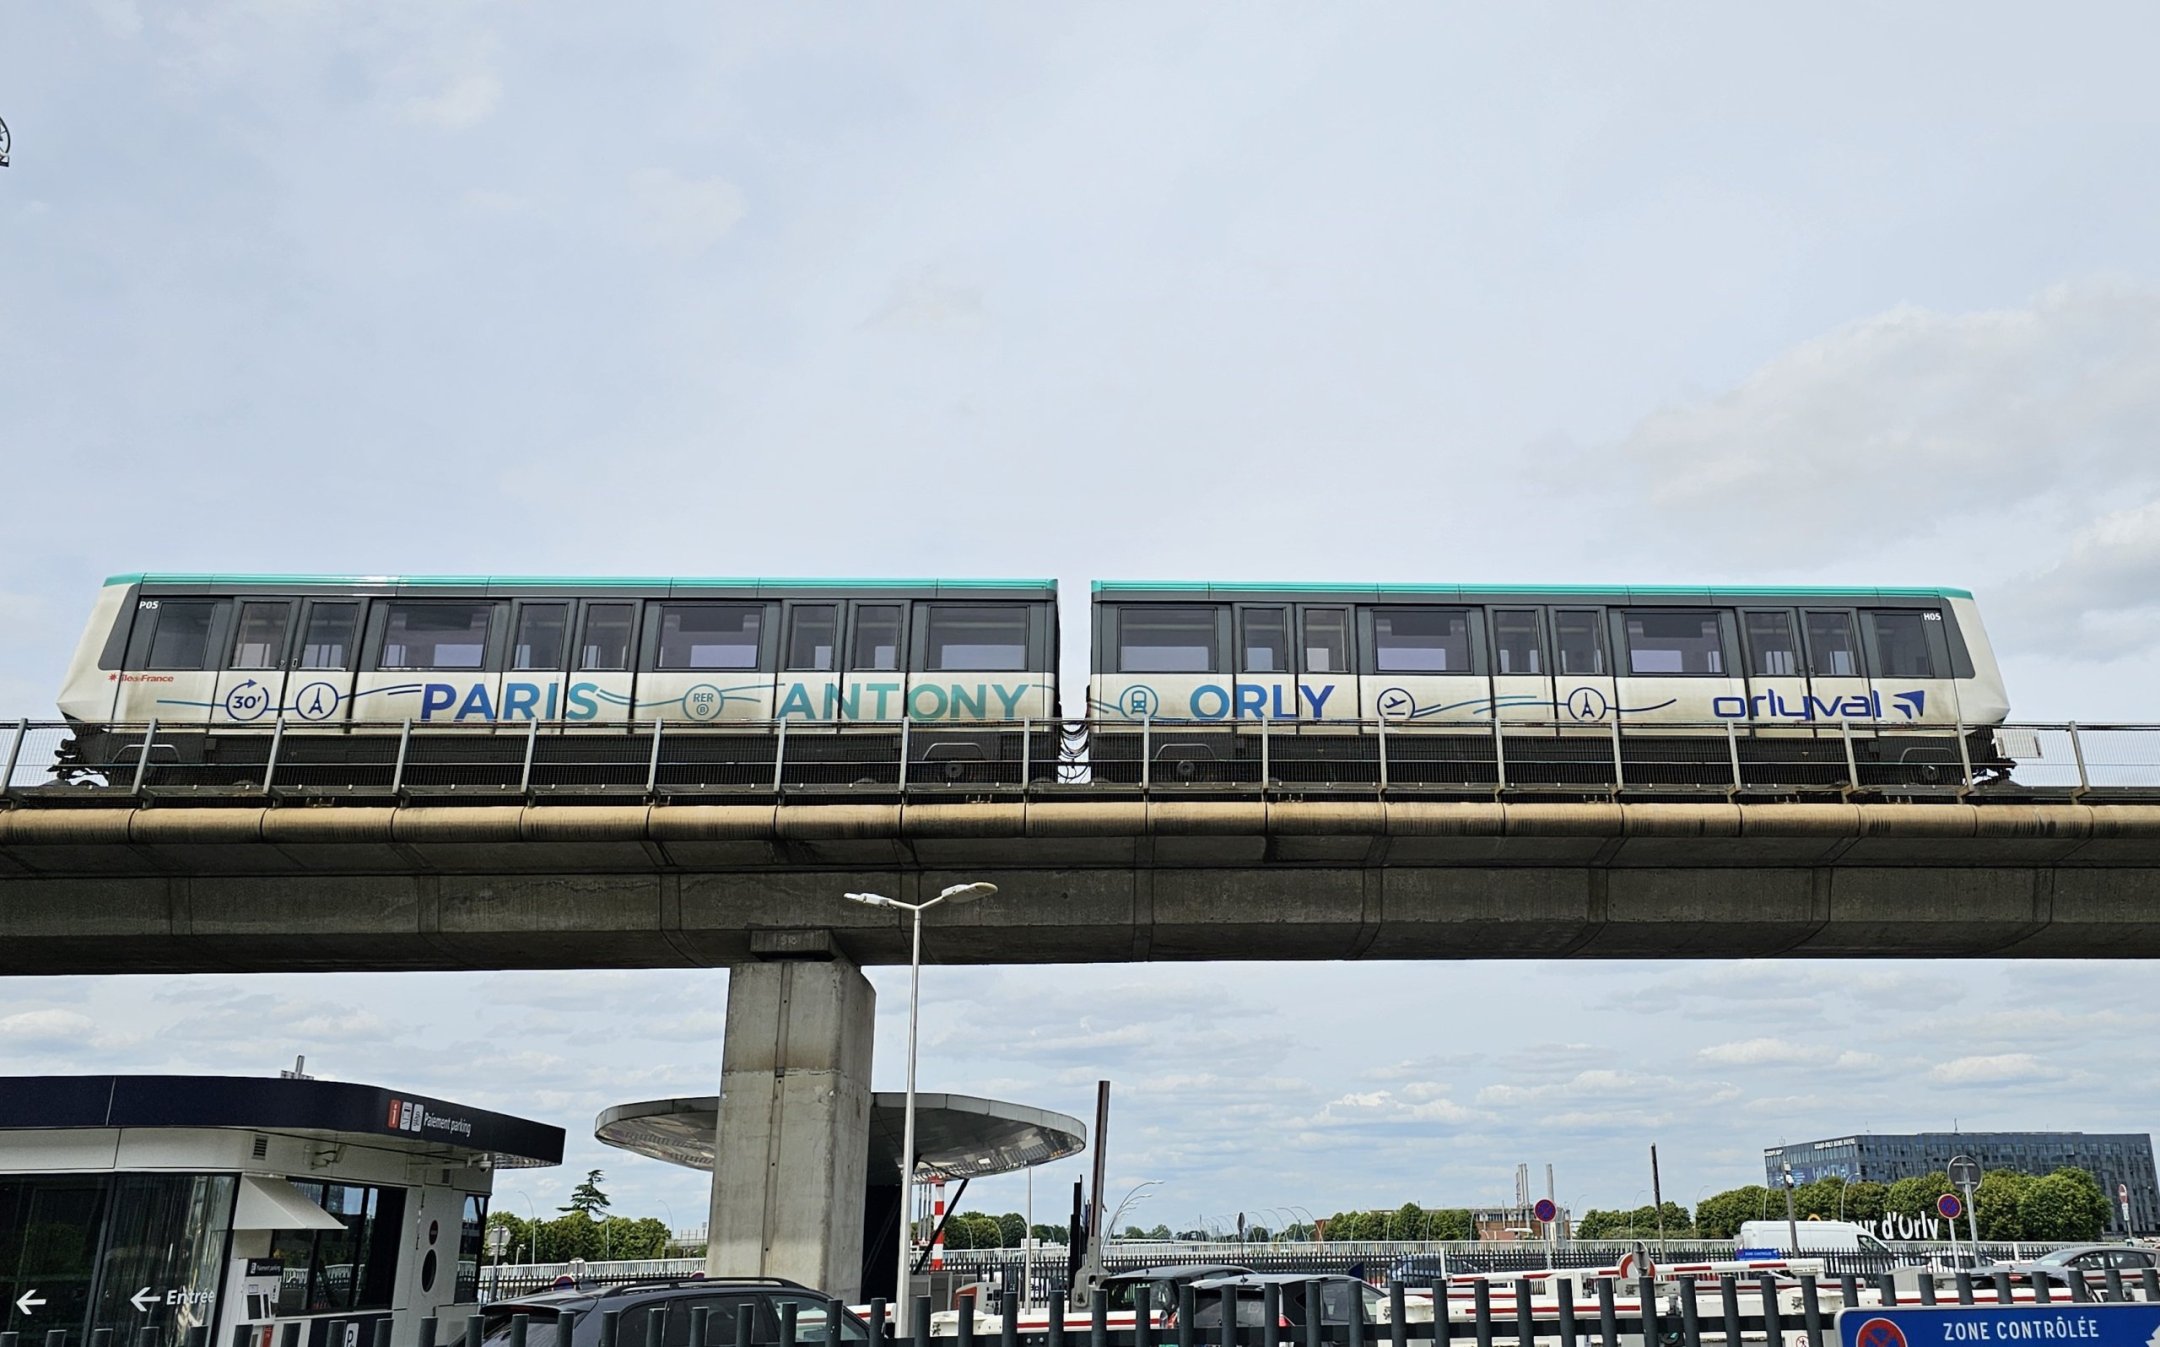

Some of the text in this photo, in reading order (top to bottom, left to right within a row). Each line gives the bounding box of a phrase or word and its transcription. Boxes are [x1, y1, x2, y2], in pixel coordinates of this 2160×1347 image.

[139, 601, 159, 609] P05
[1923, 612, 1941, 621] H05
[420, 683, 600, 722] PARIS
[693, 693, 714, 702] RER
[777, 683, 1029, 721] ANTONY
[1190, 684, 1335, 720] ORLY
[1713, 688, 1882, 721] orlyval
[423, 1112, 472, 1138] Paiement parking
[166, 1285, 215, 1305] Entrée
[1943, 1316, 2099, 1341] ZONE CONTRÔLÉE
